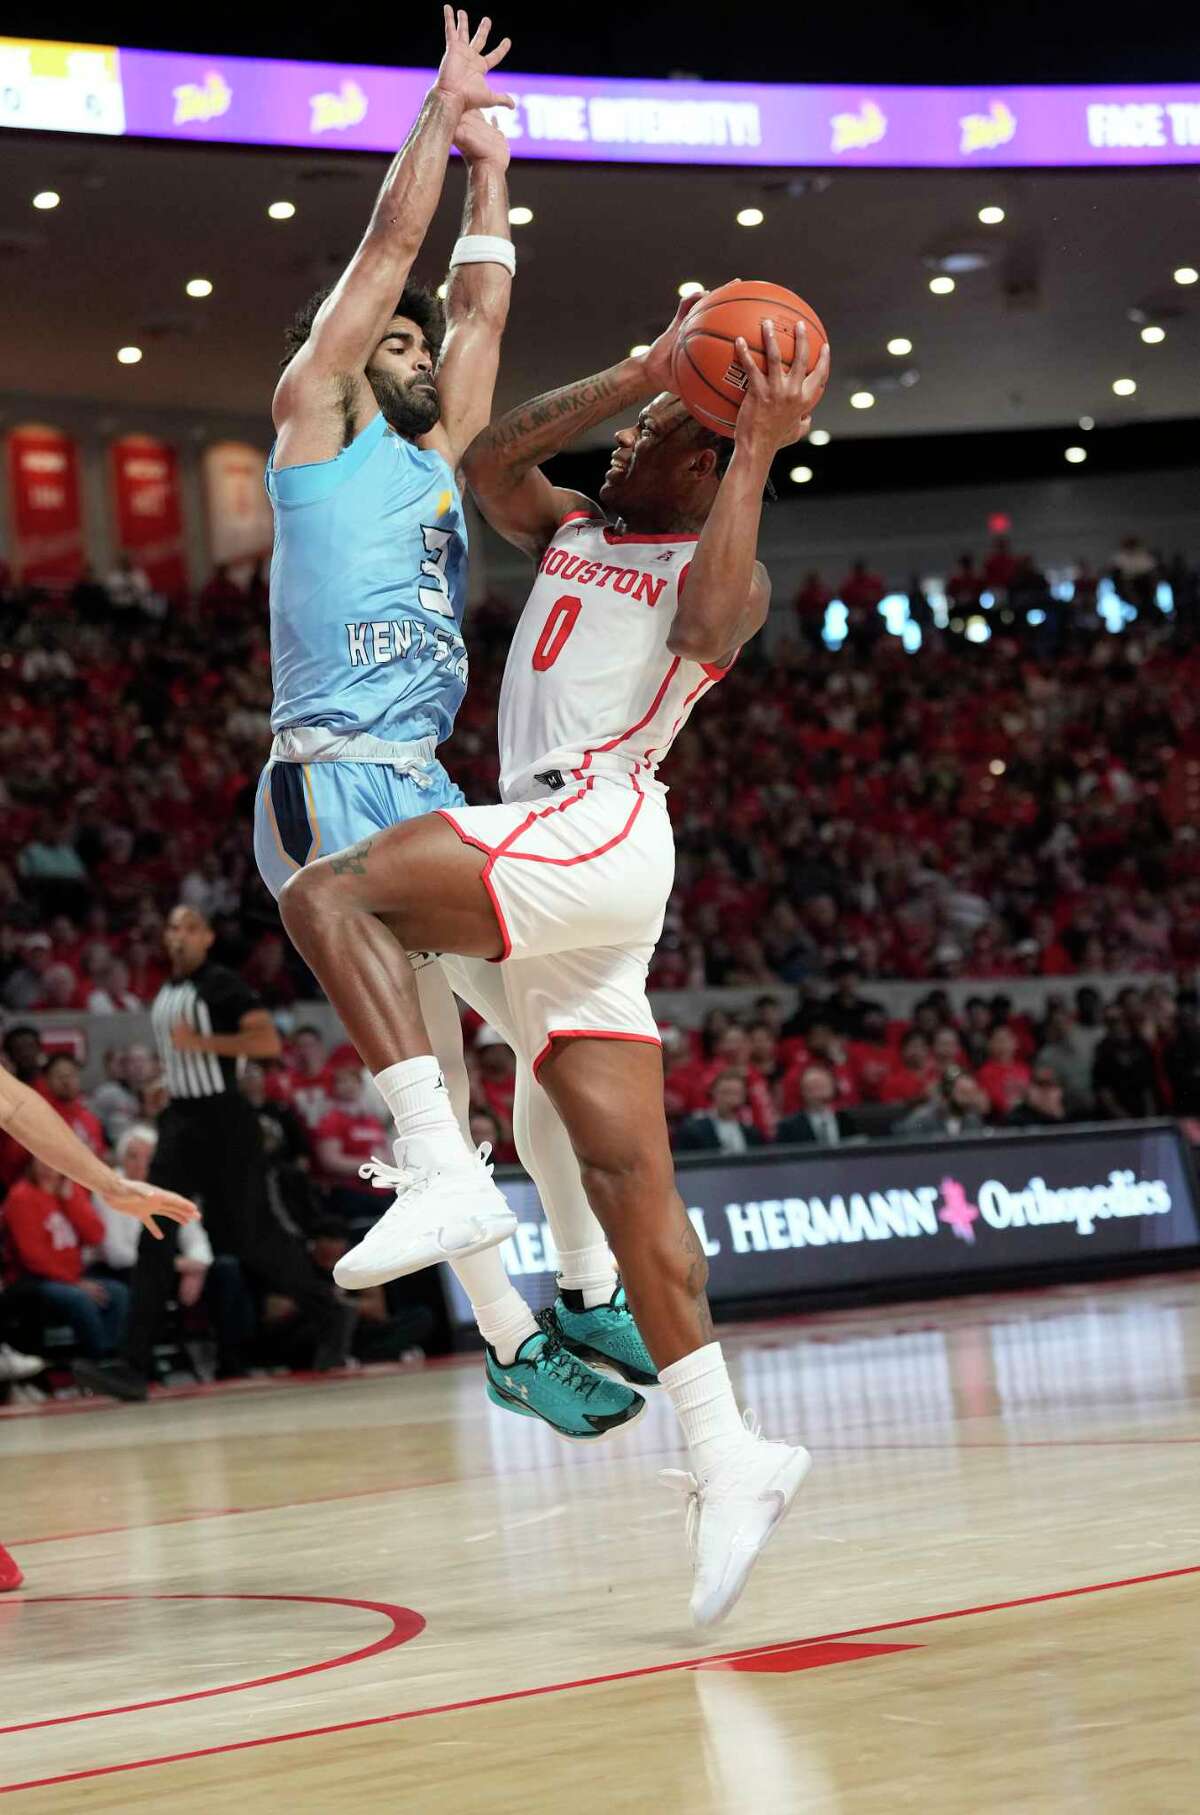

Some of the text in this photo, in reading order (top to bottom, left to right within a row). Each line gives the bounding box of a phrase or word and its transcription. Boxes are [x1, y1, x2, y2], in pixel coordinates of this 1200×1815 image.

[418, 524, 455, 620] 3
[532, 595, 583, 672] 0
[724, 1186, 939, 1254] HERMANN
[978, 1169, 1173, 1236] Orthopedics
